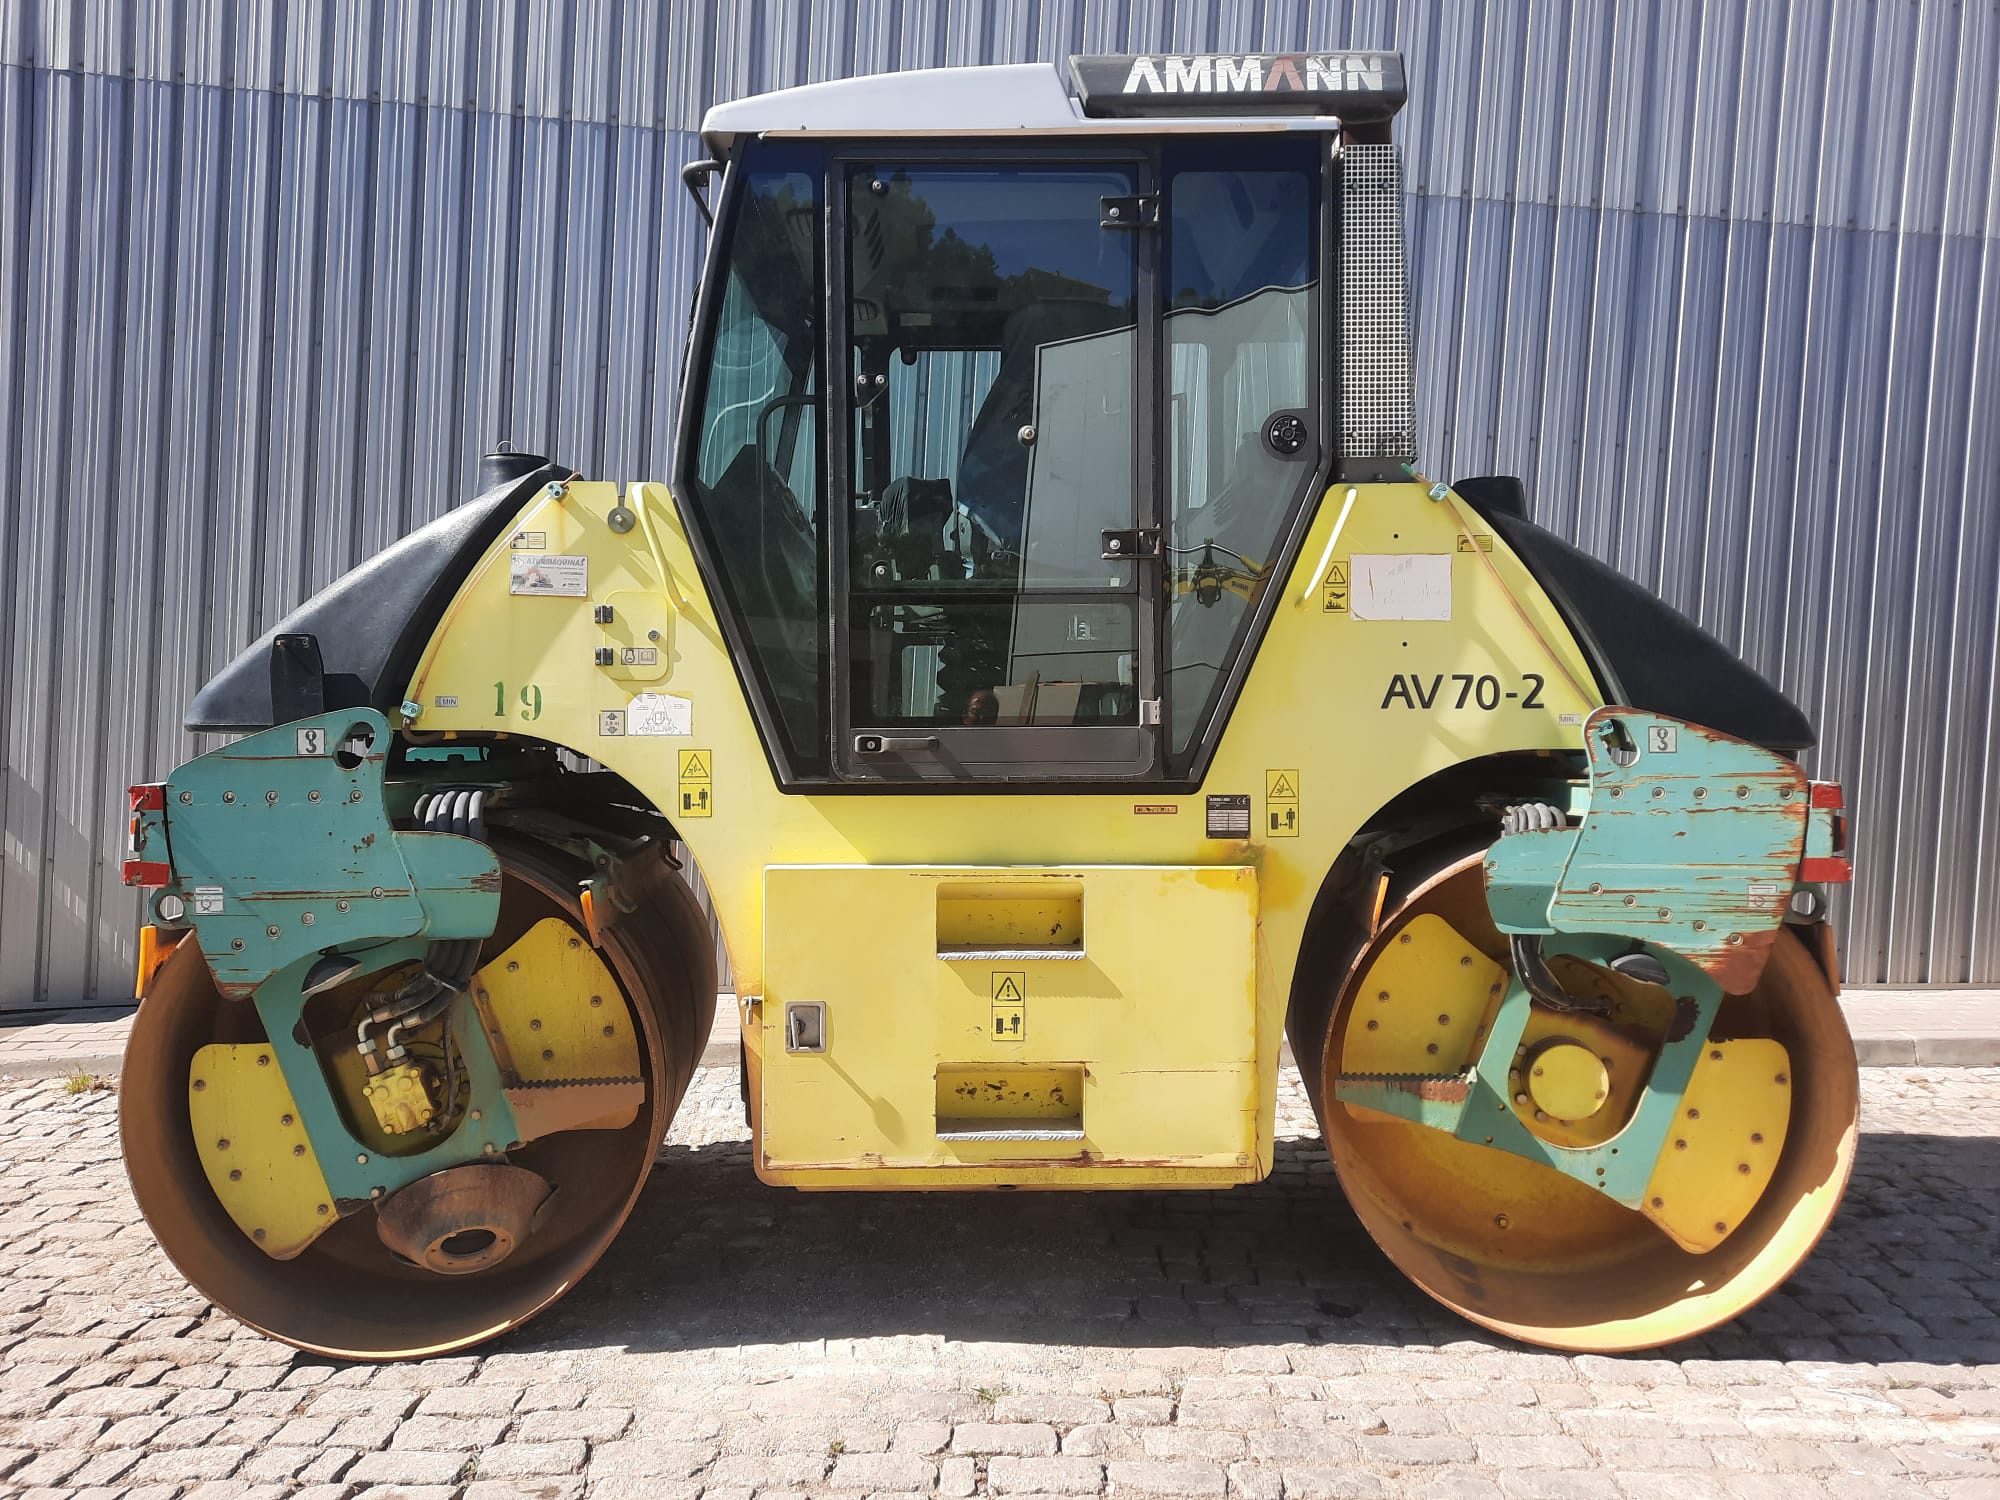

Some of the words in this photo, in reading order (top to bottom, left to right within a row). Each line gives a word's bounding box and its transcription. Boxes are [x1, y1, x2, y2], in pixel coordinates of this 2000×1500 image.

[1122, 55, 1384, 94] AMMANN
[442, 698, 457, 706] MIN
[493, 681, 542, 721] 19
[1381, 673, 1444, 710] AV
[1451, 673, 1545, 711] 70-2
[1560, 715, 1574, 723] MIN
